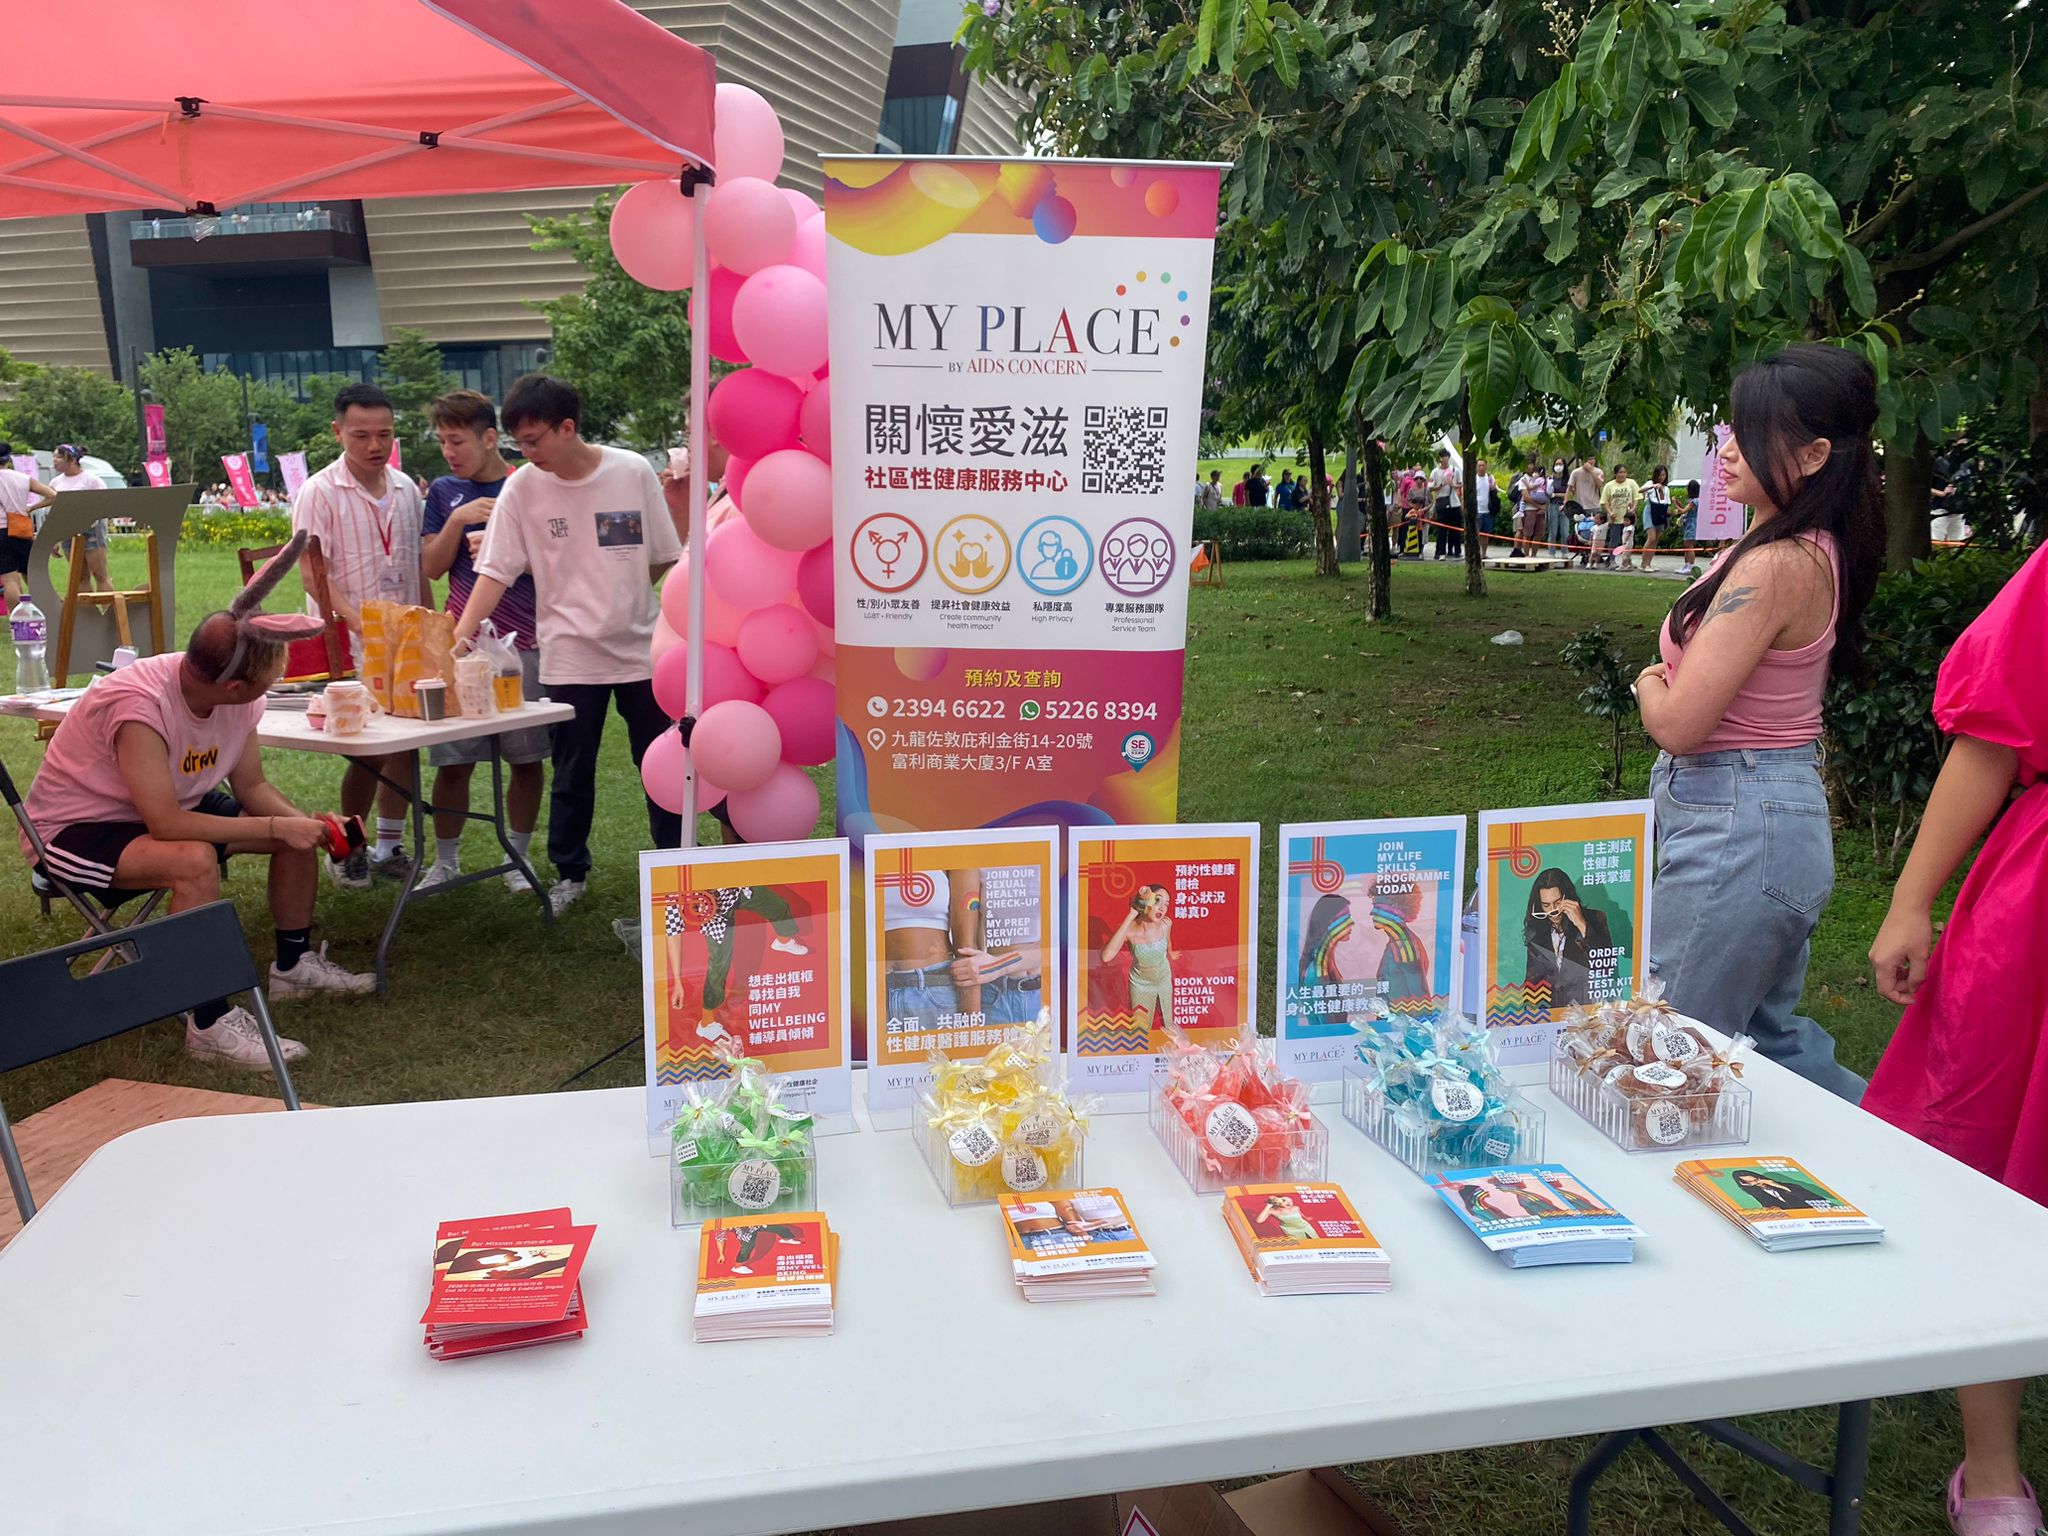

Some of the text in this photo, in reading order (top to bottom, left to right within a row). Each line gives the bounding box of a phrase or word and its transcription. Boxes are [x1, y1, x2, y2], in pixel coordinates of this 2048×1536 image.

[873, 302, 1161, 356] MY PLACE
[948, 358, 1088, 375] BY AIDS CONCERN
[865, 403, 1069, 458] 關懷愛滋
[864, 466, 1068, 492] 社區性健康服務中心
[931, 600, 1011, 612] 提昇社會健康效益
[1032, 601, 1073, 612] 私隱度高
[1105, 602, 1165, 613] 專業服務團隊
[885, 612, 913, 621] Friendly
[939, 613, 1002, 622] Create community
[1031, 615, 1074, 624] High Privacy
[1113, 616, 1155, 624] Professional
[947, 622, 994, 631] health impact
[1111, 625, 1136, 633] Service
[964, 668, 1062, 688] 預約及查詢
[892, 698, 1006, 719] 2394 6622
[1044, 700, 1158, 721] 5226 8394
[891, 730, 1094, 750] 九龍佐敦庇利金街14-20號
[1131, 740, 1145, 749] SE
[891, 752, 1053, 772] 富利商業大廈3/F A室
[1377, 842, 1404, 852] JOIN
[1583, 839, 1632, 856] 自主測試
[1377, 851, 1422, 862] MY LIFE
[1174, 863, 1235, 877] 預約性健康
[1377, 862, 1417, 873] SKILLS
[1583, 857, 1619, 871] 性健康
[986, 868, 1035, 881] JOIN OUR
[1376, 871, 1450, 884] PROGRAMME
[1583, 870, 1631, 886] 由我掌握
[986, 879, 1026, 890] SEXUAL
[1174, 878, 1199, 891] 體檢
[1376, 884, 1415, 895] TODAY
[986, 888, 1026, 899] HEALTH
[1174, 891, 1226, 905] 身心狀況
[986, 897, 1039, 909] CHECK-UP
[986, 909, 994, 919] &
[1174, 906, 1209, 919] 睇真D
[986, 917, 1031, 929] MY PREP
[986, 927, 1030, 938] SERVICE
[986, 938, 1011, 948] NOW
[1588, 947, 1625, 959] ORDER
[1588, 958, 1617, 969] YOUR
[748, 970, 814, 987] 想走出框框
[1588, 968, 1614, 979] SELF
[1174, 976, 1235, 987] BOOK YOUR
[1588, 977, 1634, 989] TEST KIT
[748, 986, 801, 1002] 尋找自我
[1174, 987, 1215, 997] SEXUAL
[1286, 981, 1390, 1000] 人生最重要的一課
[1588, 988, 1624, 1000] TODAY
[1174, 996, 1215, 1006] HEALTH
[748, 1003, 781, 1016] 同MY
[1174, 1005, 1209, 1015] CHECK
[748, 1012, 826, 1030] WELLBEING
[886, 1011, 986, 1034] 全面、共融的
[1174, 1015, 1198, 1025] NOW
[749, 1027, 814, 1045] 輔導員傾傾
[1514, 1034, 1542, 1045] PLACE
[1294, 1050, 1340, 1061] MY PLACE
[1086, 1063, 1135, 1075] MY PLACE
[887, 1077, 901, 1087] MY
